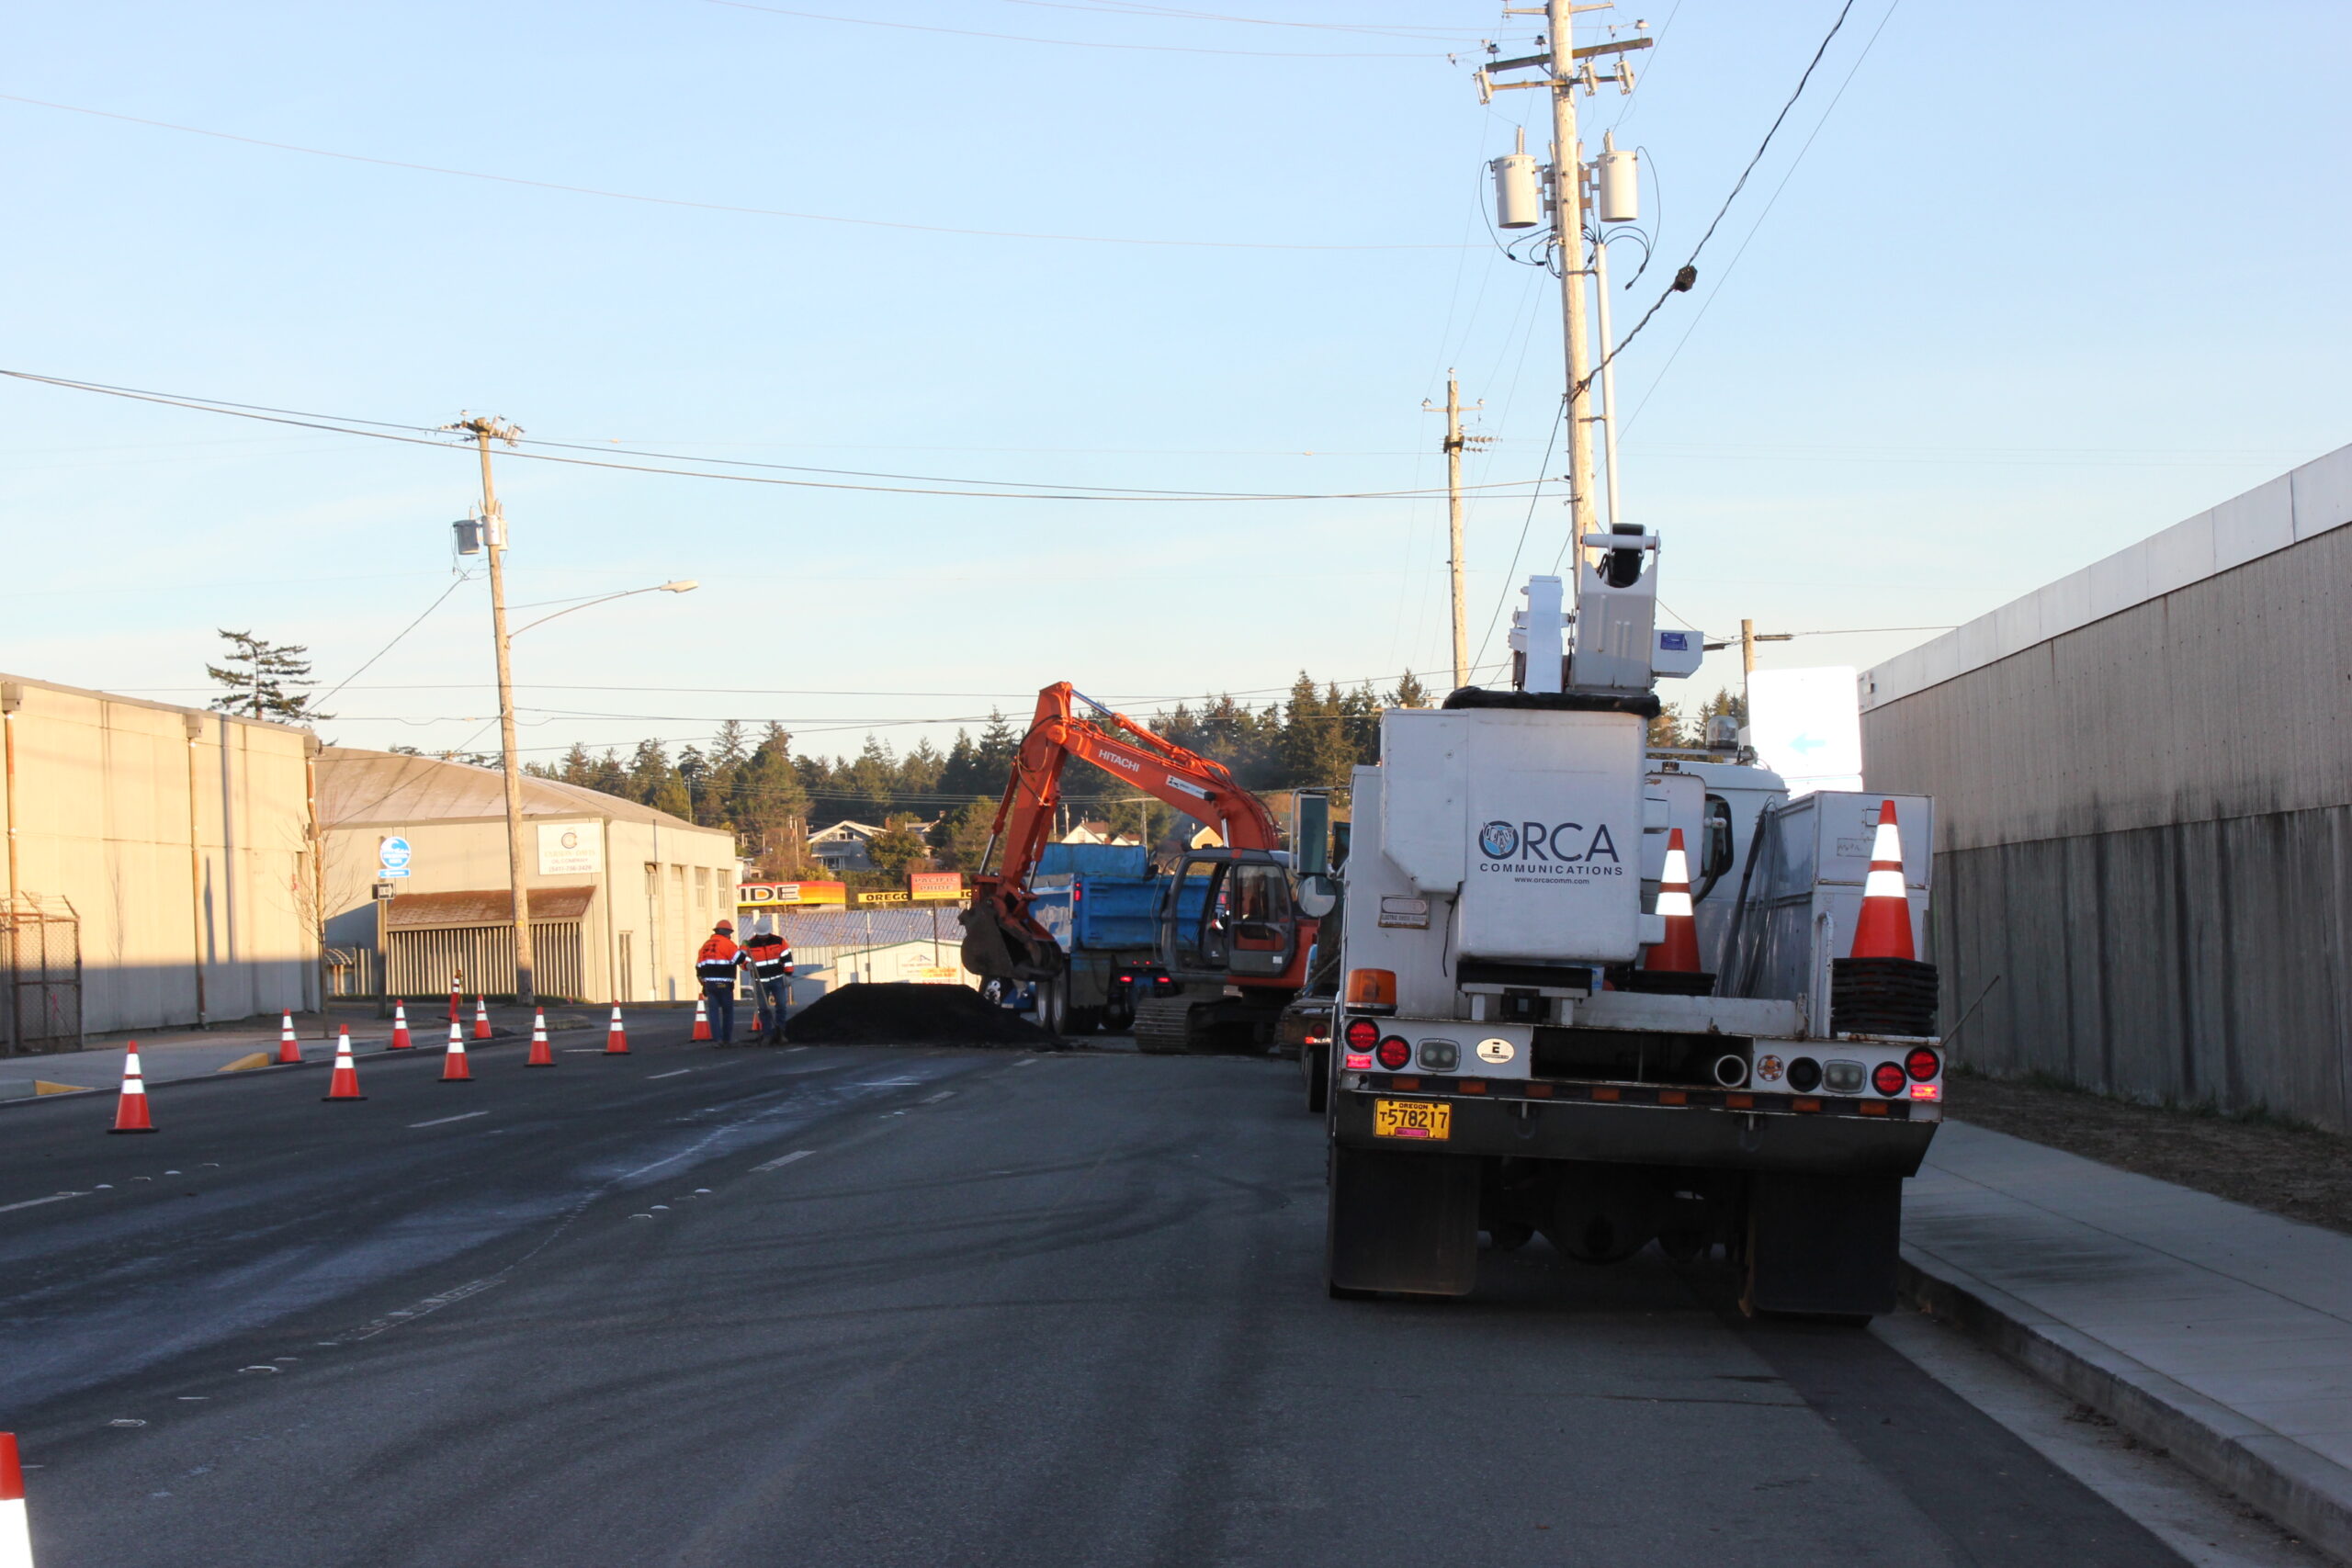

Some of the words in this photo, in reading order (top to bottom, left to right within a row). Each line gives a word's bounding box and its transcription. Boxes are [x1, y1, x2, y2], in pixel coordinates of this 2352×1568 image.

[1098, 749, 1140, 773] HITACHI
[1478, 820, 1620, 863] ORCA
[1479, 863, 1623, 875] COMMUNICATIONS
[1514, 876, 1589, 885] www.orcacomm.com
[739, 885, 799, 903] IDE
[865, 893, 908, 901] OREGO
[1379, 1109, 1448, 1129] T578217
